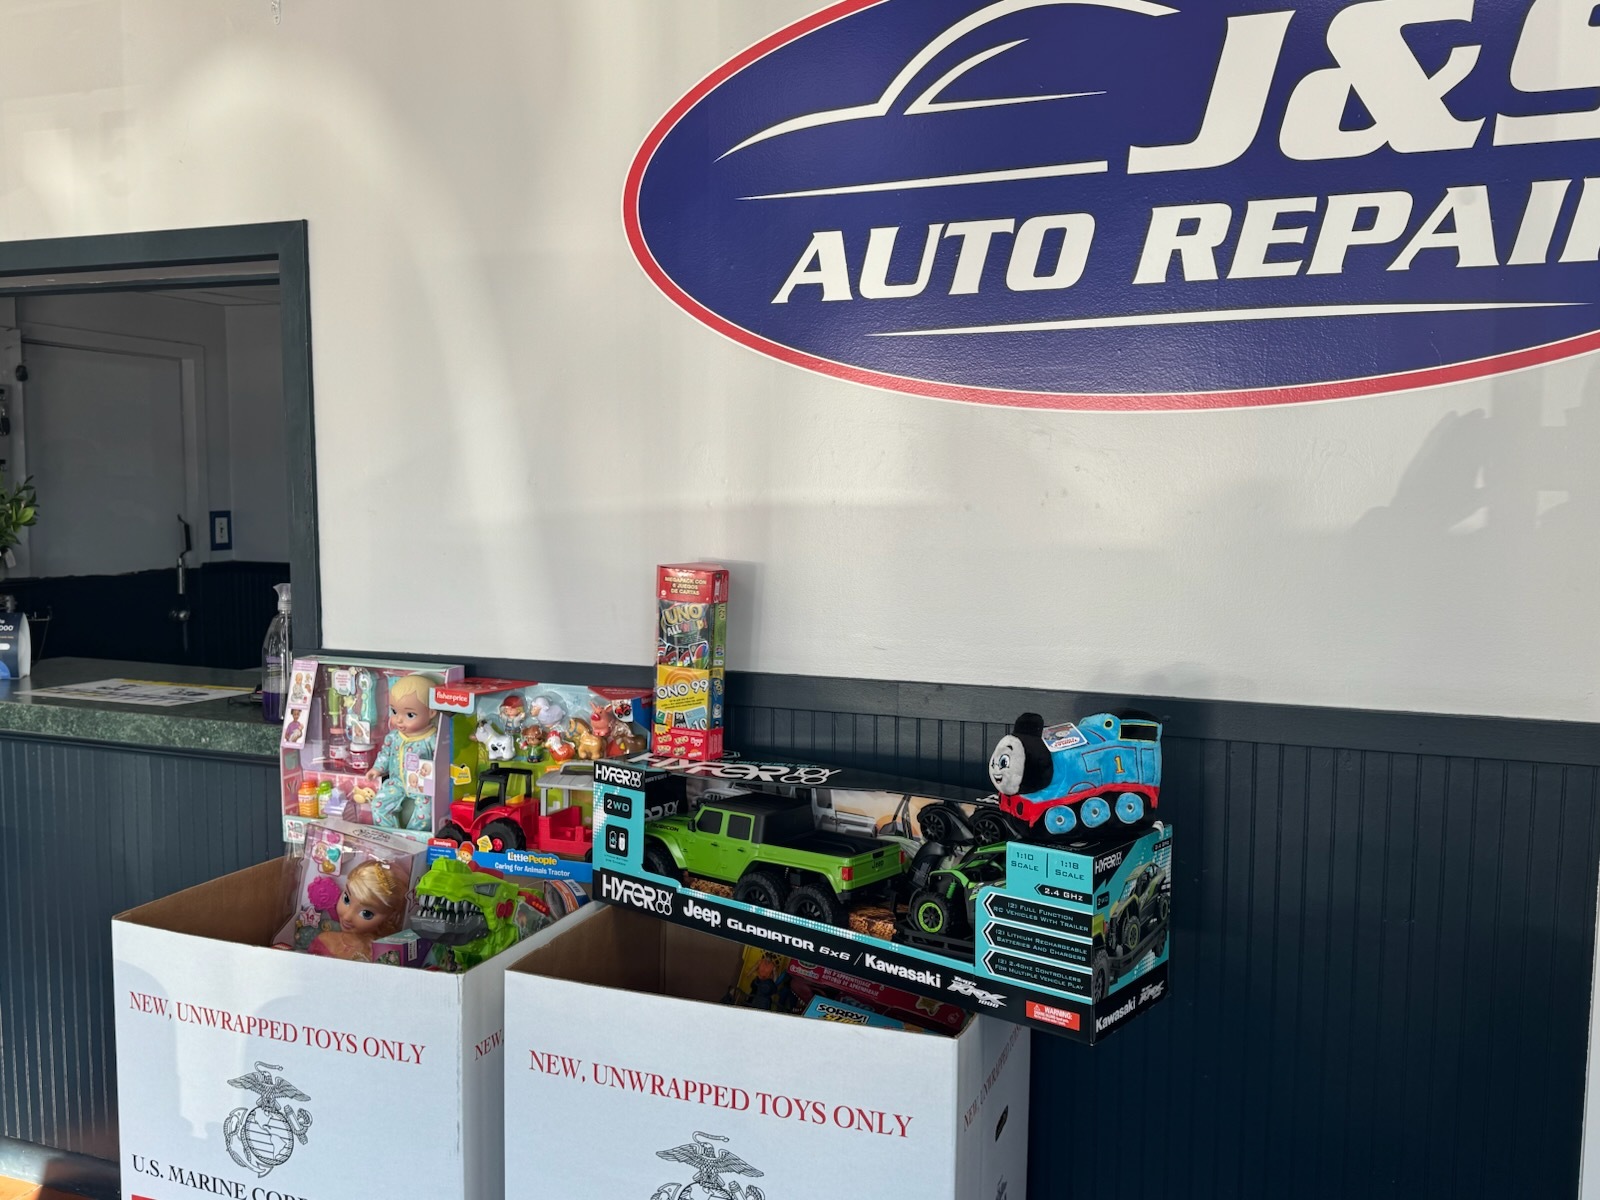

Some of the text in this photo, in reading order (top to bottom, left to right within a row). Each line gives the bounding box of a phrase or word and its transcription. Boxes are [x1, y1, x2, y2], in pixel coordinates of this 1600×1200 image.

[771, 212, 1096, 304] AUTO
[664, 603, 703, 625] UNO
[656, 683, 689, 699] ONO
[691, 679, 709, 694] 99
[1114, 756, 1125, 773] 1
[606, 799, 630, 812] 2WD
[507, 852, 557, 866] Little People
[1016, 851, 1034, 861] 1:10
[1060, 860, 1080, 870] 1:18
[494, 862, 571, 877] Caring for Animals Tractor
[1010, 860, 1039, 872] SCALE
[1055, 869, 1085, 881] SCALE
[1044, 887, 1060, 897] 2.4
[683, 899, 721, 928] Jeep
[726, 917, 815, 952] GLADIATOR
[819, 945, 851, 961] 6x6
[865, 953, 941, 988] Kawasaki
[816, 1003, 869, 1025] SORRY!
[1095, 996, 1136, 1033] Kawasaki
[129, 991, 426, 1066] NEW, UNWRAPPED TOYS ONLY
[528, 1049, 914, 1139] NEW, UNWRAPPED TOYS ONLY
[132, 1154, 164, 1179] U.S.
[168, 1165, 248, 1200] MARINE
